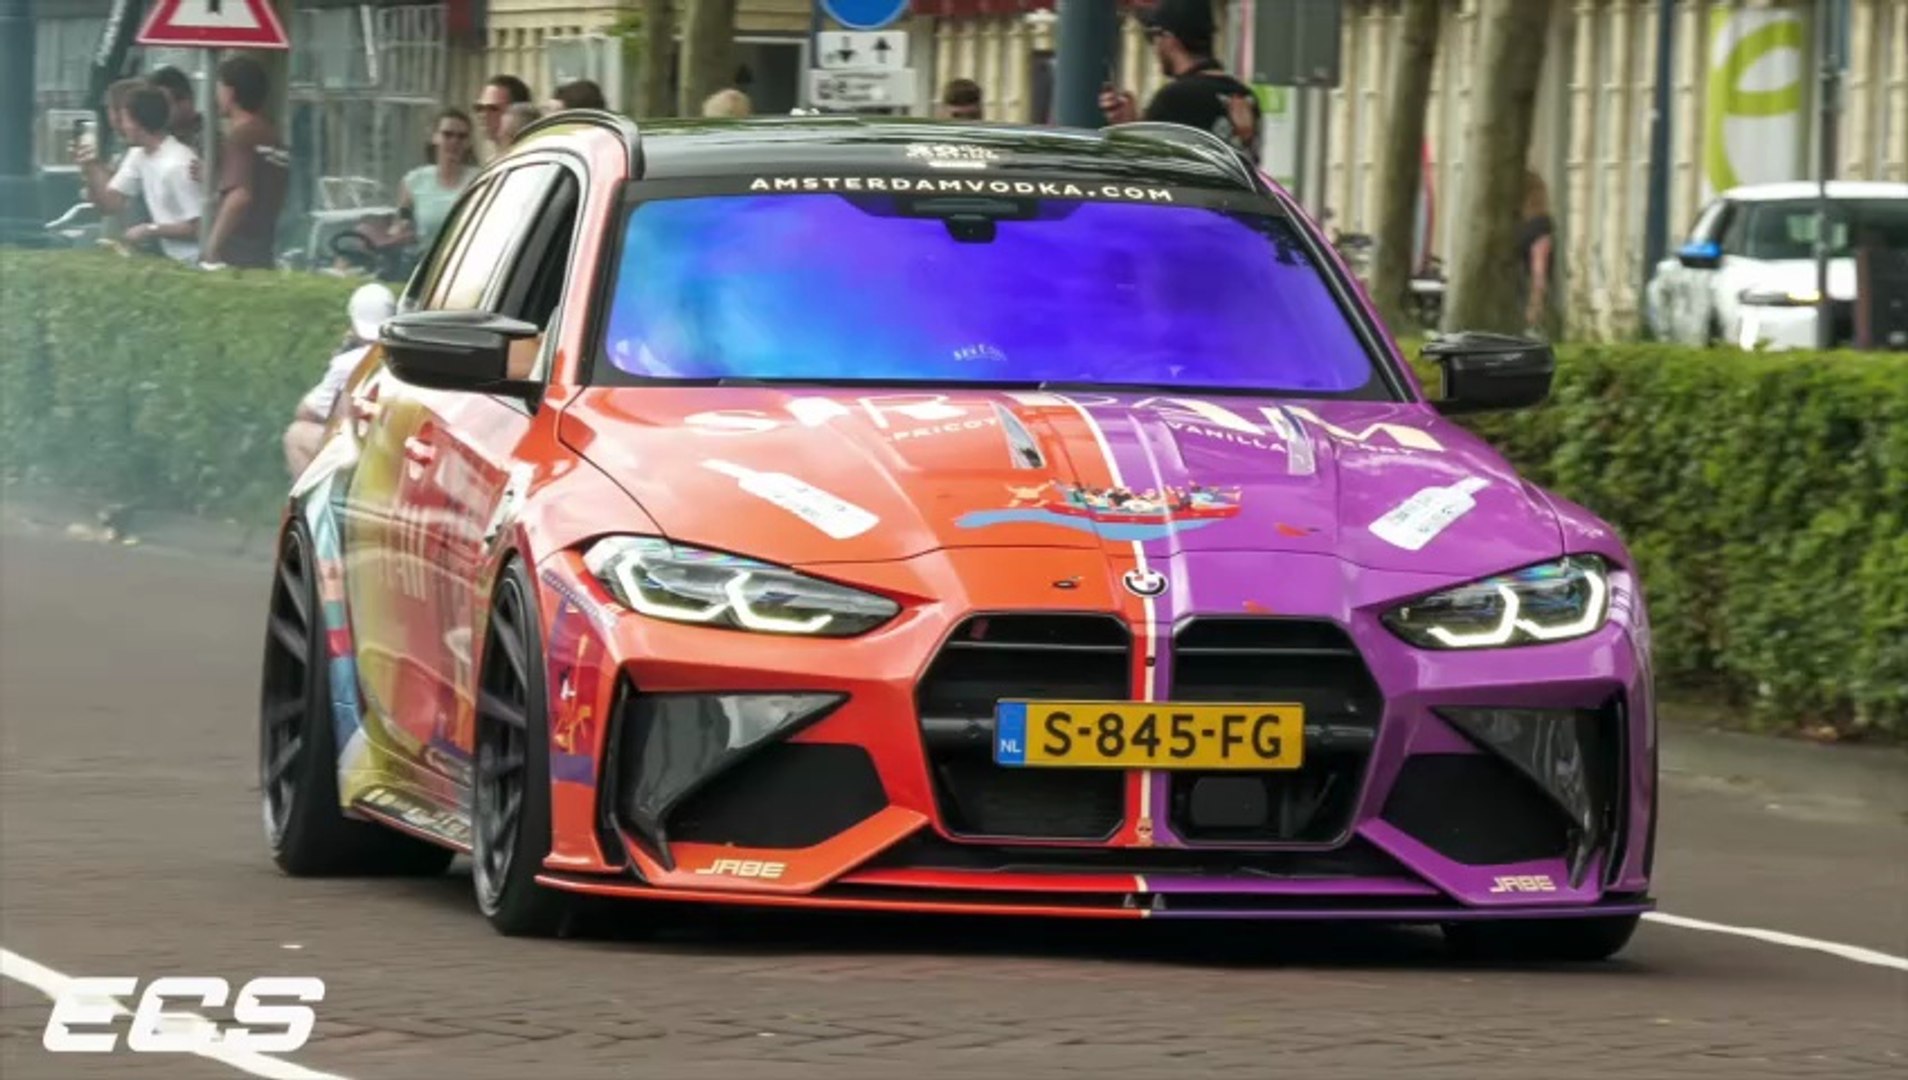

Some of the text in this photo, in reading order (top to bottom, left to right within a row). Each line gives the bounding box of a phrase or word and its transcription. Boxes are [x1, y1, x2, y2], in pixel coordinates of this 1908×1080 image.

[750, 177, 1173, 201] AMSTERDAMVODKA.COM
[1166, 420, 1287, 454] VANILLA
[1043, 711, 1282, 759] S-845-FG
[1000, 740, 1022, 754] NL
[695, 859, 786, 879] JABE
[1489, 875, 1557, 893] JABE
